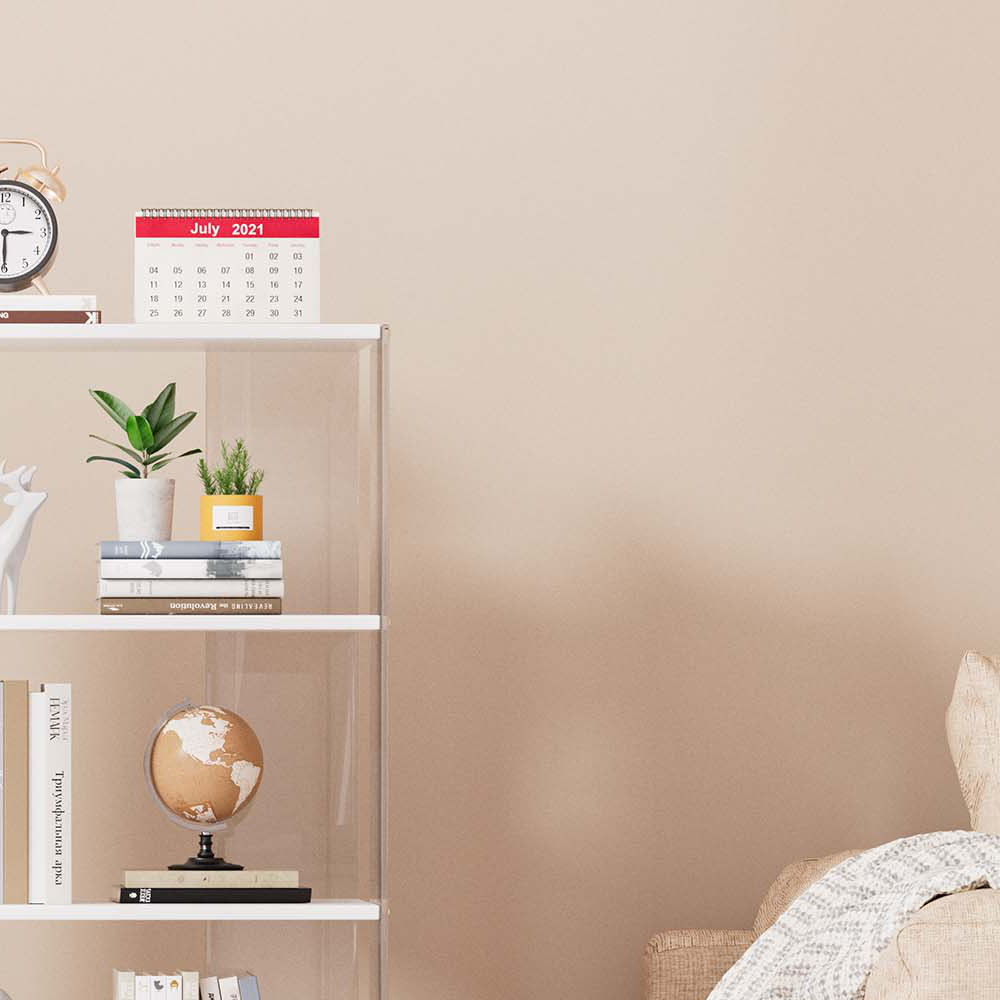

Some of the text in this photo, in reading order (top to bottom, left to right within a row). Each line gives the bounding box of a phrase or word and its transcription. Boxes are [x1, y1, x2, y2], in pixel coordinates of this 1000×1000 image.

[0, 192, 11, 203] 12
[21, 197, 25, 207] 1
[34, 209, 41, 220] 2
[40, 228, 47, 238] 3
[190, 222, 264, 236] July 2021
[33, 245, 40, 255] 4
[1, 263, 8, 273] 6
[22, 258, 29, 268] 5
[149, 295, 303, 303] 18 19 20 21 22 23 24
[149, 309, 303, 317] 25 26 27 28 29 30 31
[170, 602, 273, 610] REVEALING Revolution
[51, 770, 65, 886] Триумфальная арка
